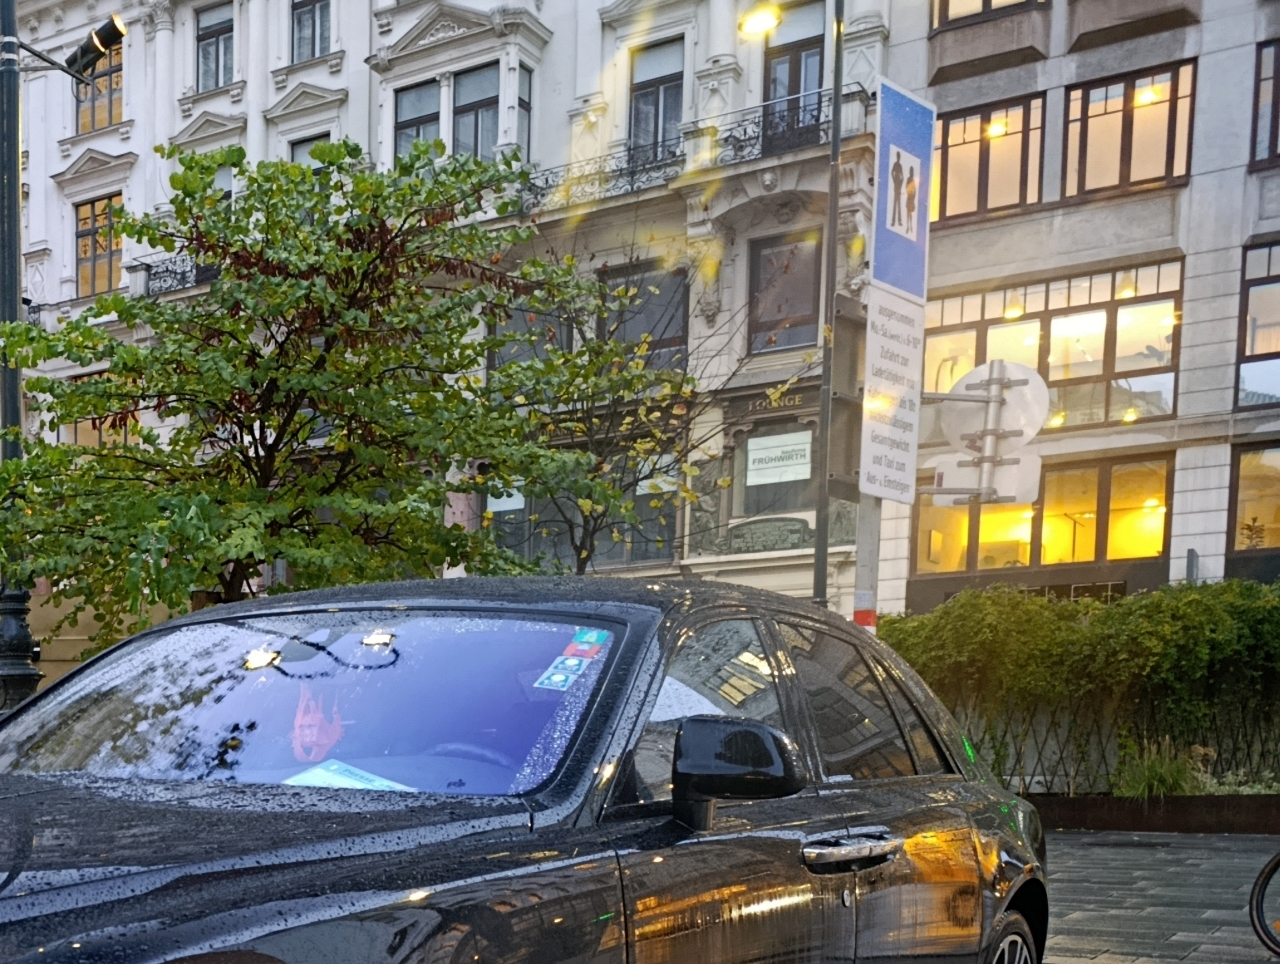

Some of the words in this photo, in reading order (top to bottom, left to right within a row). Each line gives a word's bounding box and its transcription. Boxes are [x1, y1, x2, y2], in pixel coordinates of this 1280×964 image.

[878, 305, 915, 328] ausgenommen
[880, 345, 900, 364] Zufahrt
[900, 355, 909, 367] zur
[870, 429, 910, 452] Gesamtgewicht
[752, 452, 807, 466] FRÜHWIRTH
[872, 453, 883, 466] und
[883, 454, 895, 469] Taxi
[895, 460, 906, 473] zum
[883, 474, 910, 494] Einsteigen
